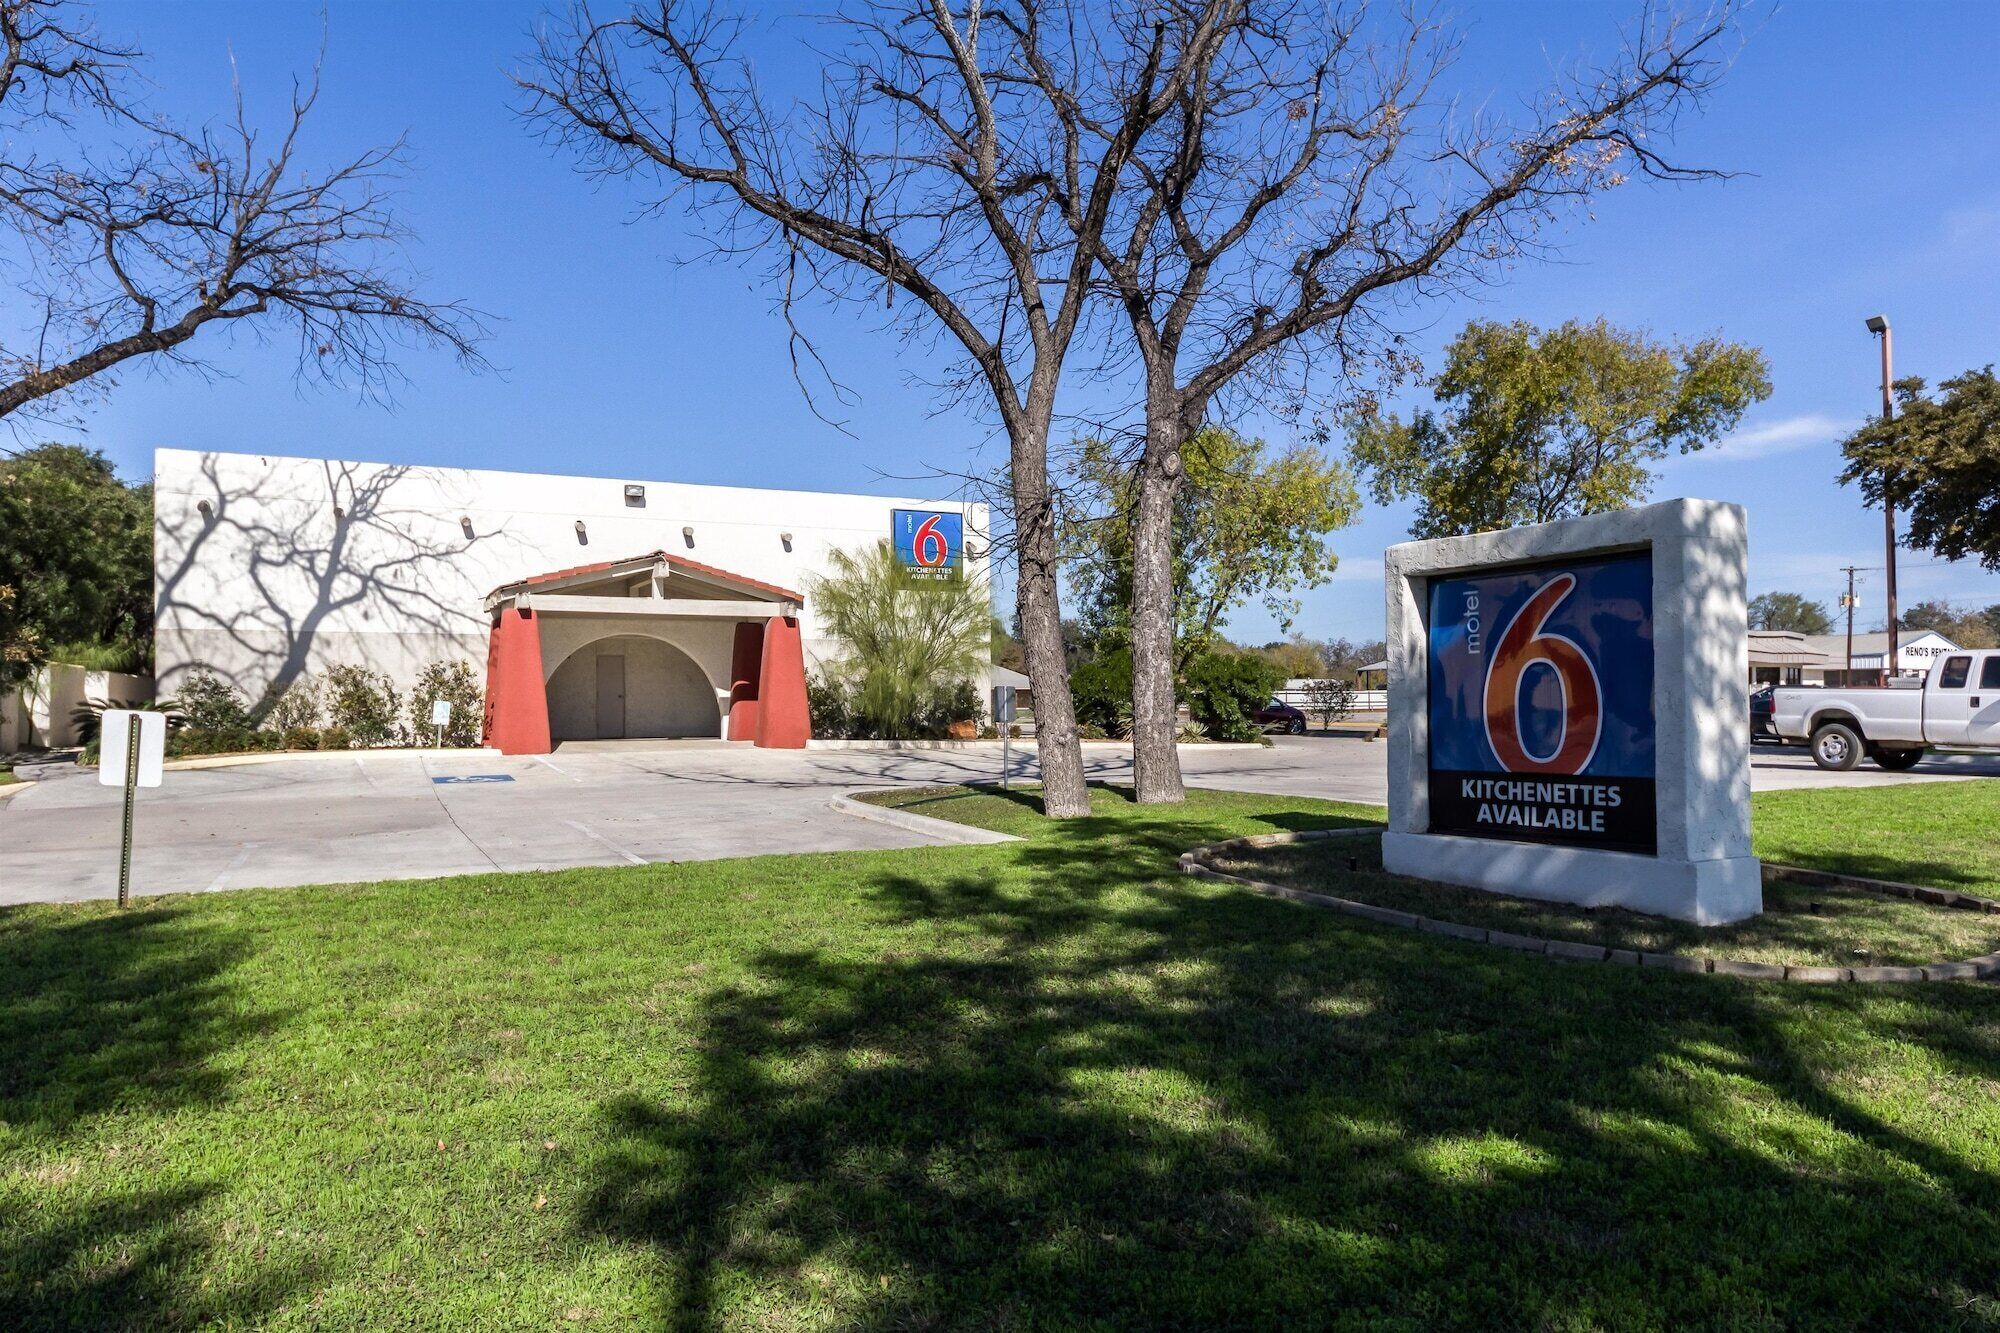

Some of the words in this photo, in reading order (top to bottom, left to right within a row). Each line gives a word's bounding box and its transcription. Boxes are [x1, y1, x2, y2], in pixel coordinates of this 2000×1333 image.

[913, 514, 948, 566] 6
[1462, 590, 1480, 654] motel
[1906, 647, 1928, 656] RENO'S
[1483, 572, 1603, 775] 6
[1461, 779, 1622, 807] KITCHENETTES
[1476, 803, 1606, 832] AVAILABLE
